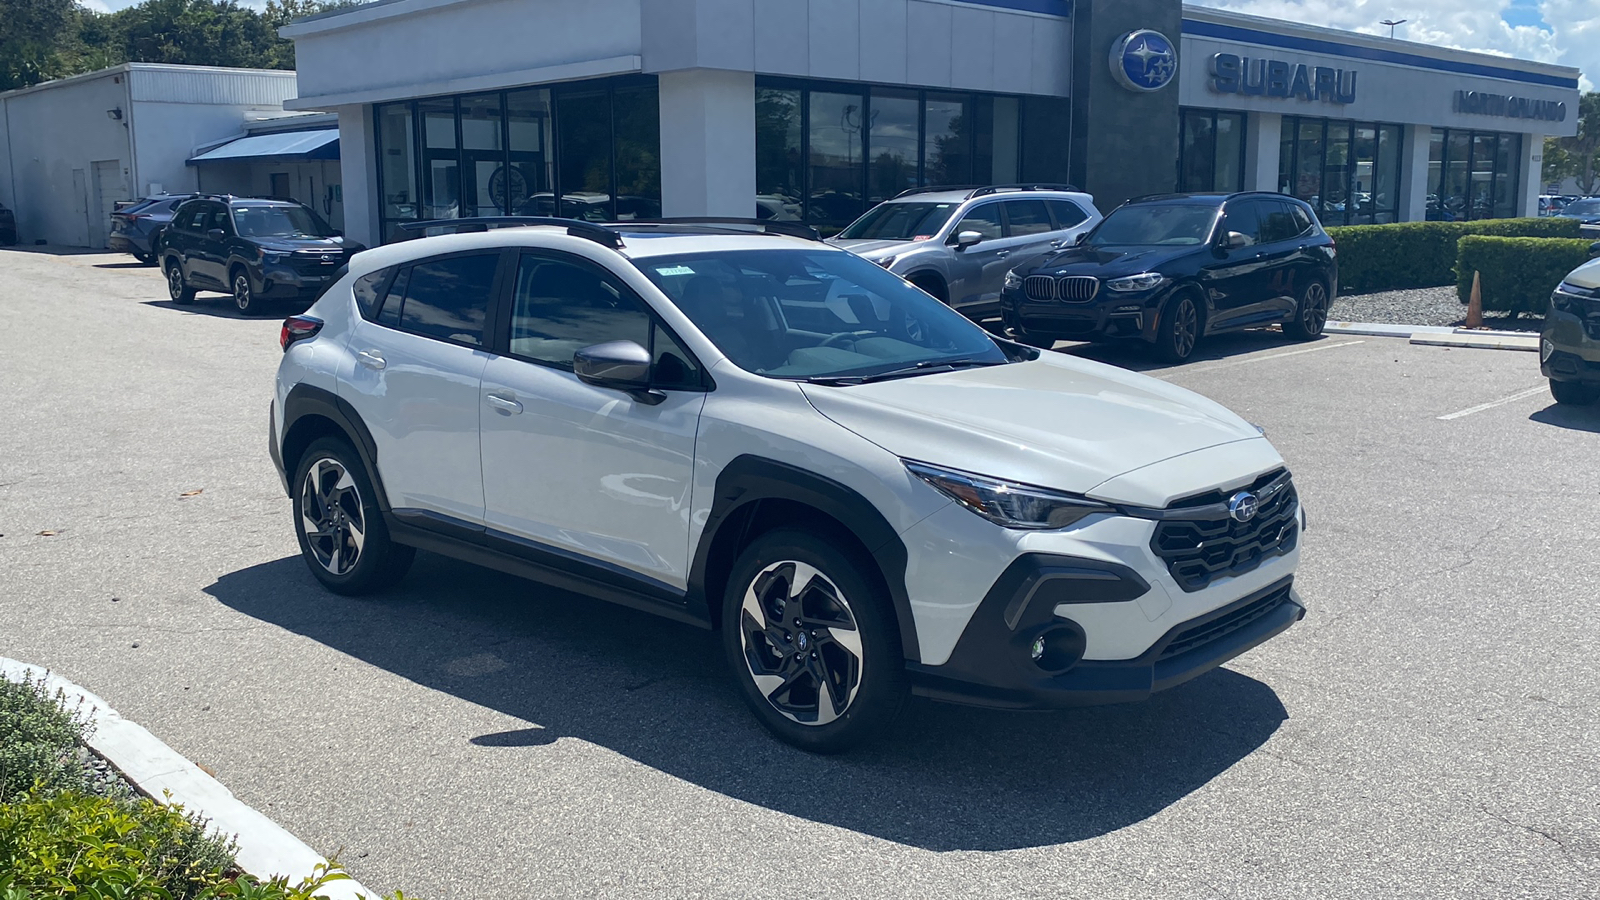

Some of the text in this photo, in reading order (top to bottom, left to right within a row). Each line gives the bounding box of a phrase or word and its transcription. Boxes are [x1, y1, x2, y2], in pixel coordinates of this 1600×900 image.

[1210, 52, 1357, 104] SUBARU
[1454, 90, 1566, 122] NORTH ORLANDO
